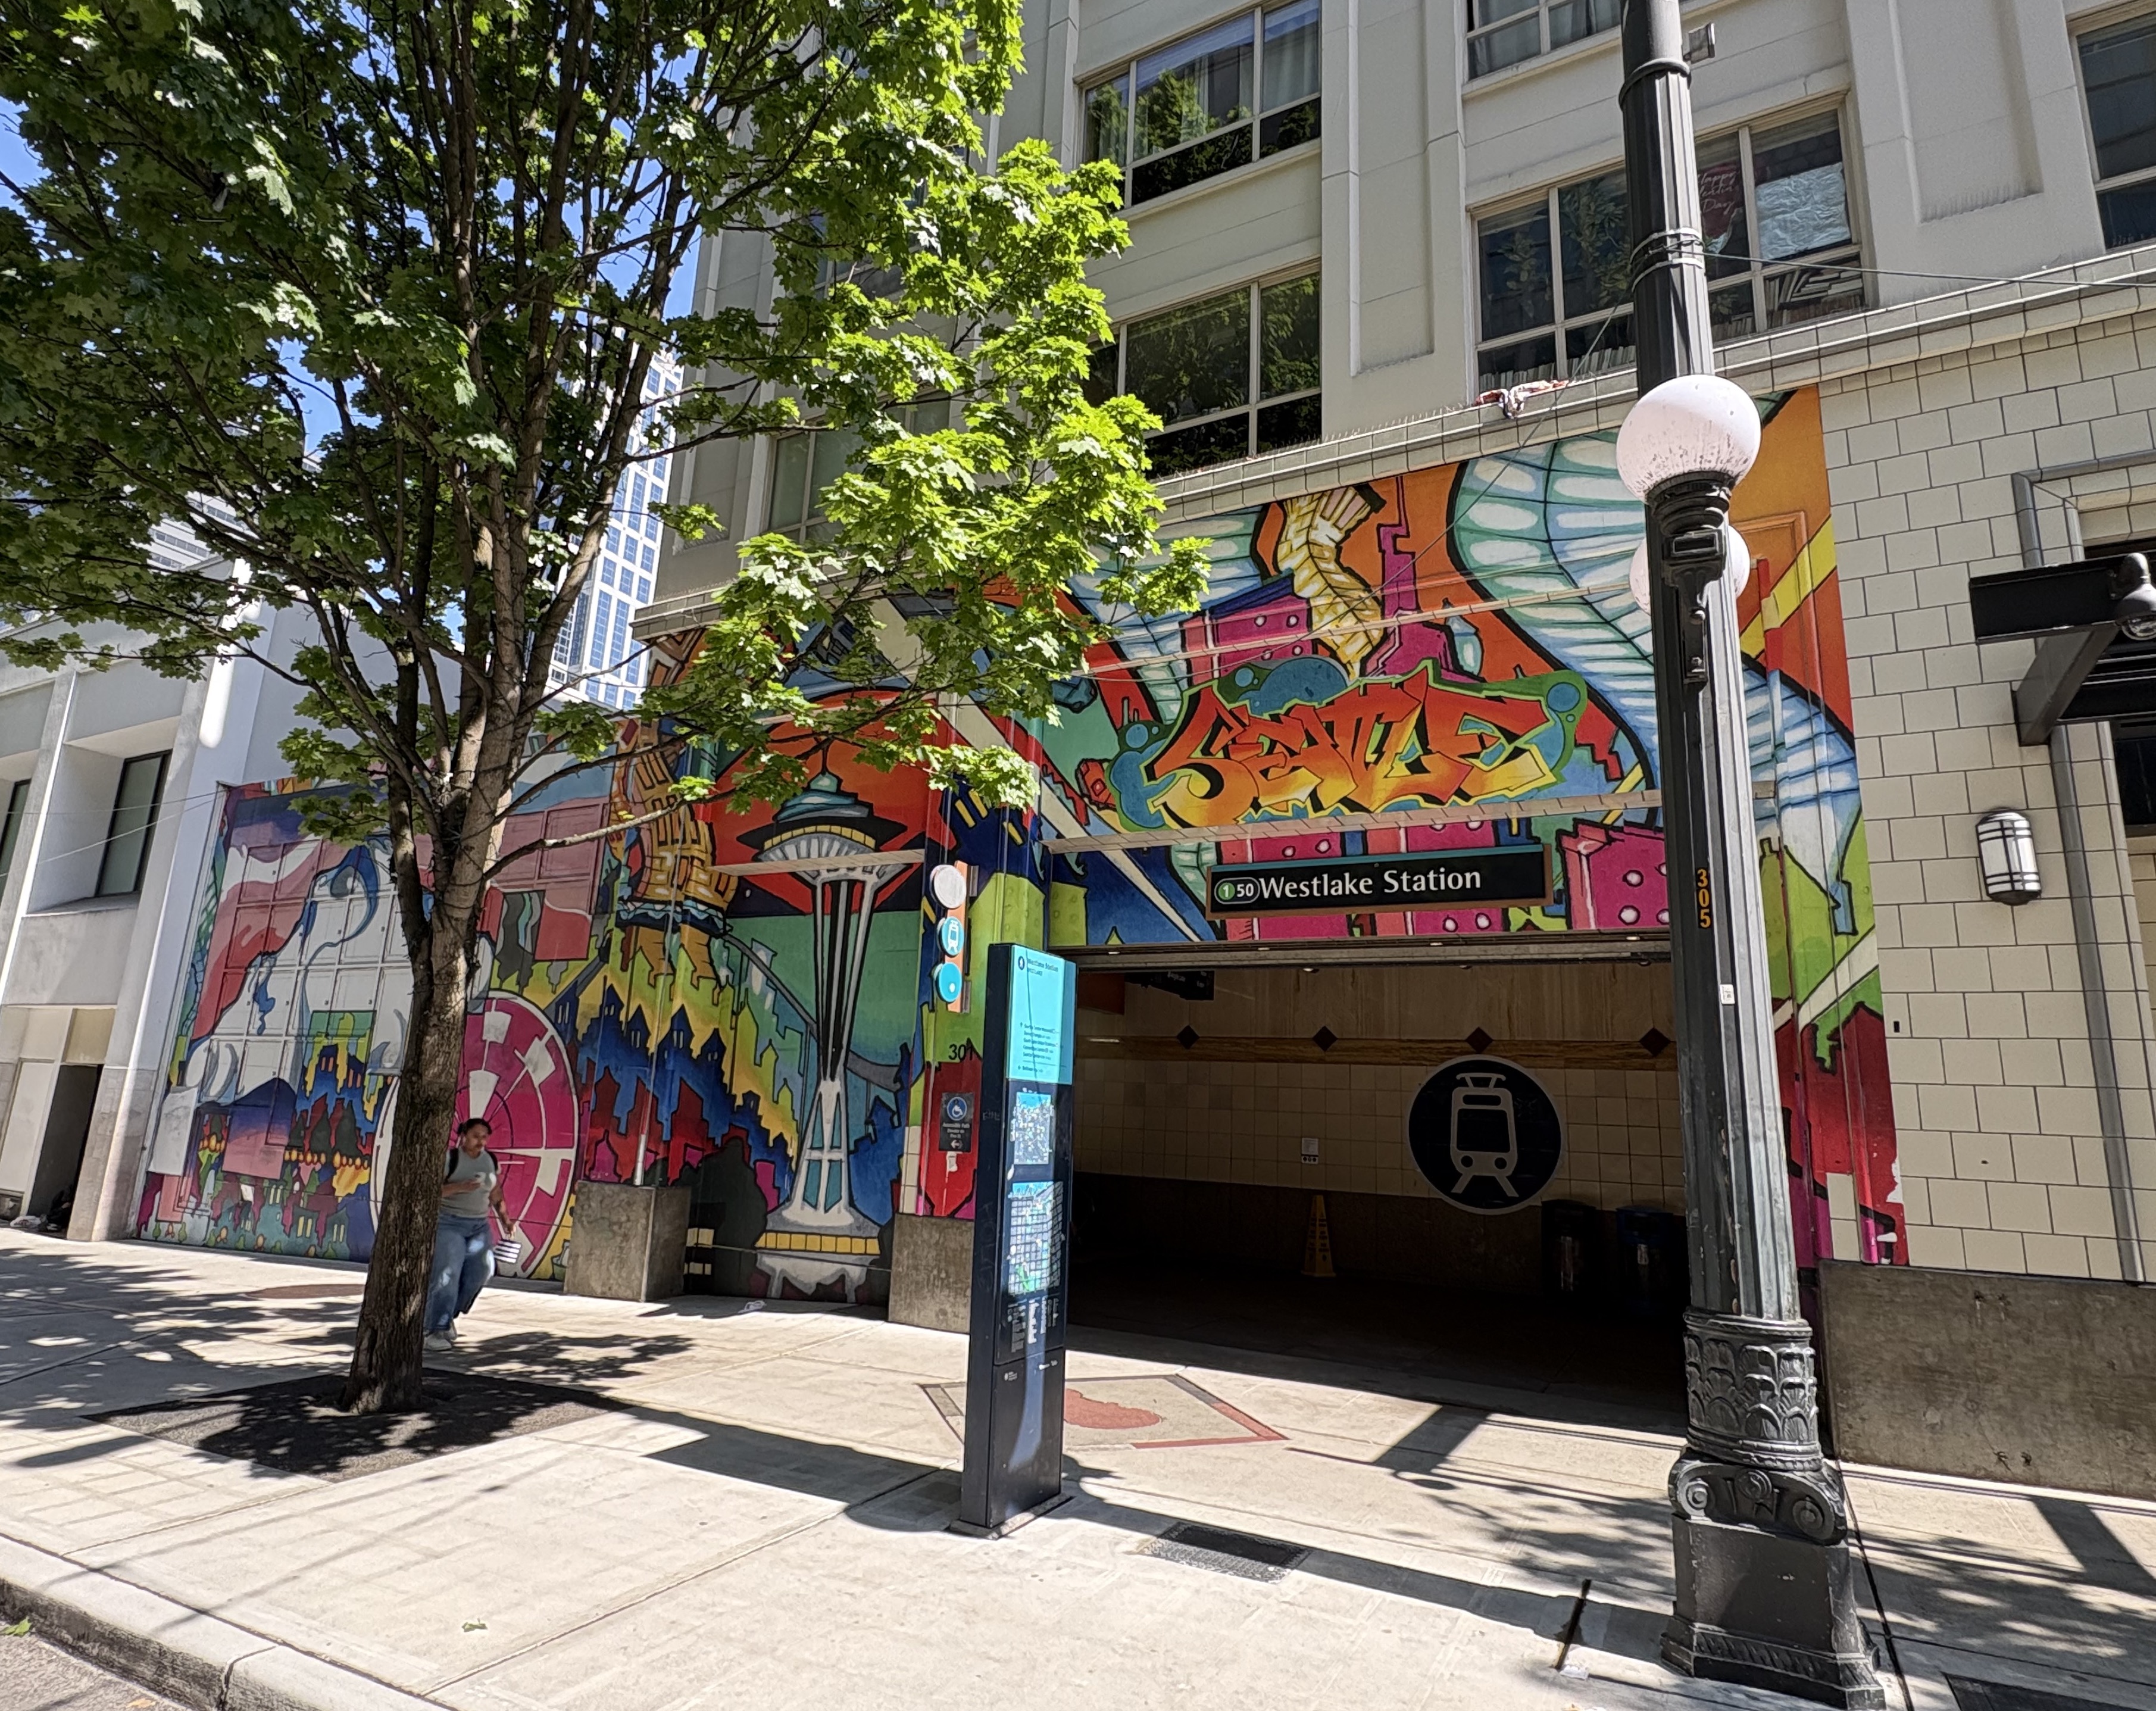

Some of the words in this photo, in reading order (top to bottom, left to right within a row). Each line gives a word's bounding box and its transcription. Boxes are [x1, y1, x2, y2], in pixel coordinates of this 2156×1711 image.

[1701, 198, 1735, 215] Day
[1236, 883, 1254, 897] 50
[1260, 873, 1373, 898] Westlake
[1384, 867, 1481, 893] Station
[1696, 869, 1711, 928] 305
[948, 1043, 973, 1061] 301
